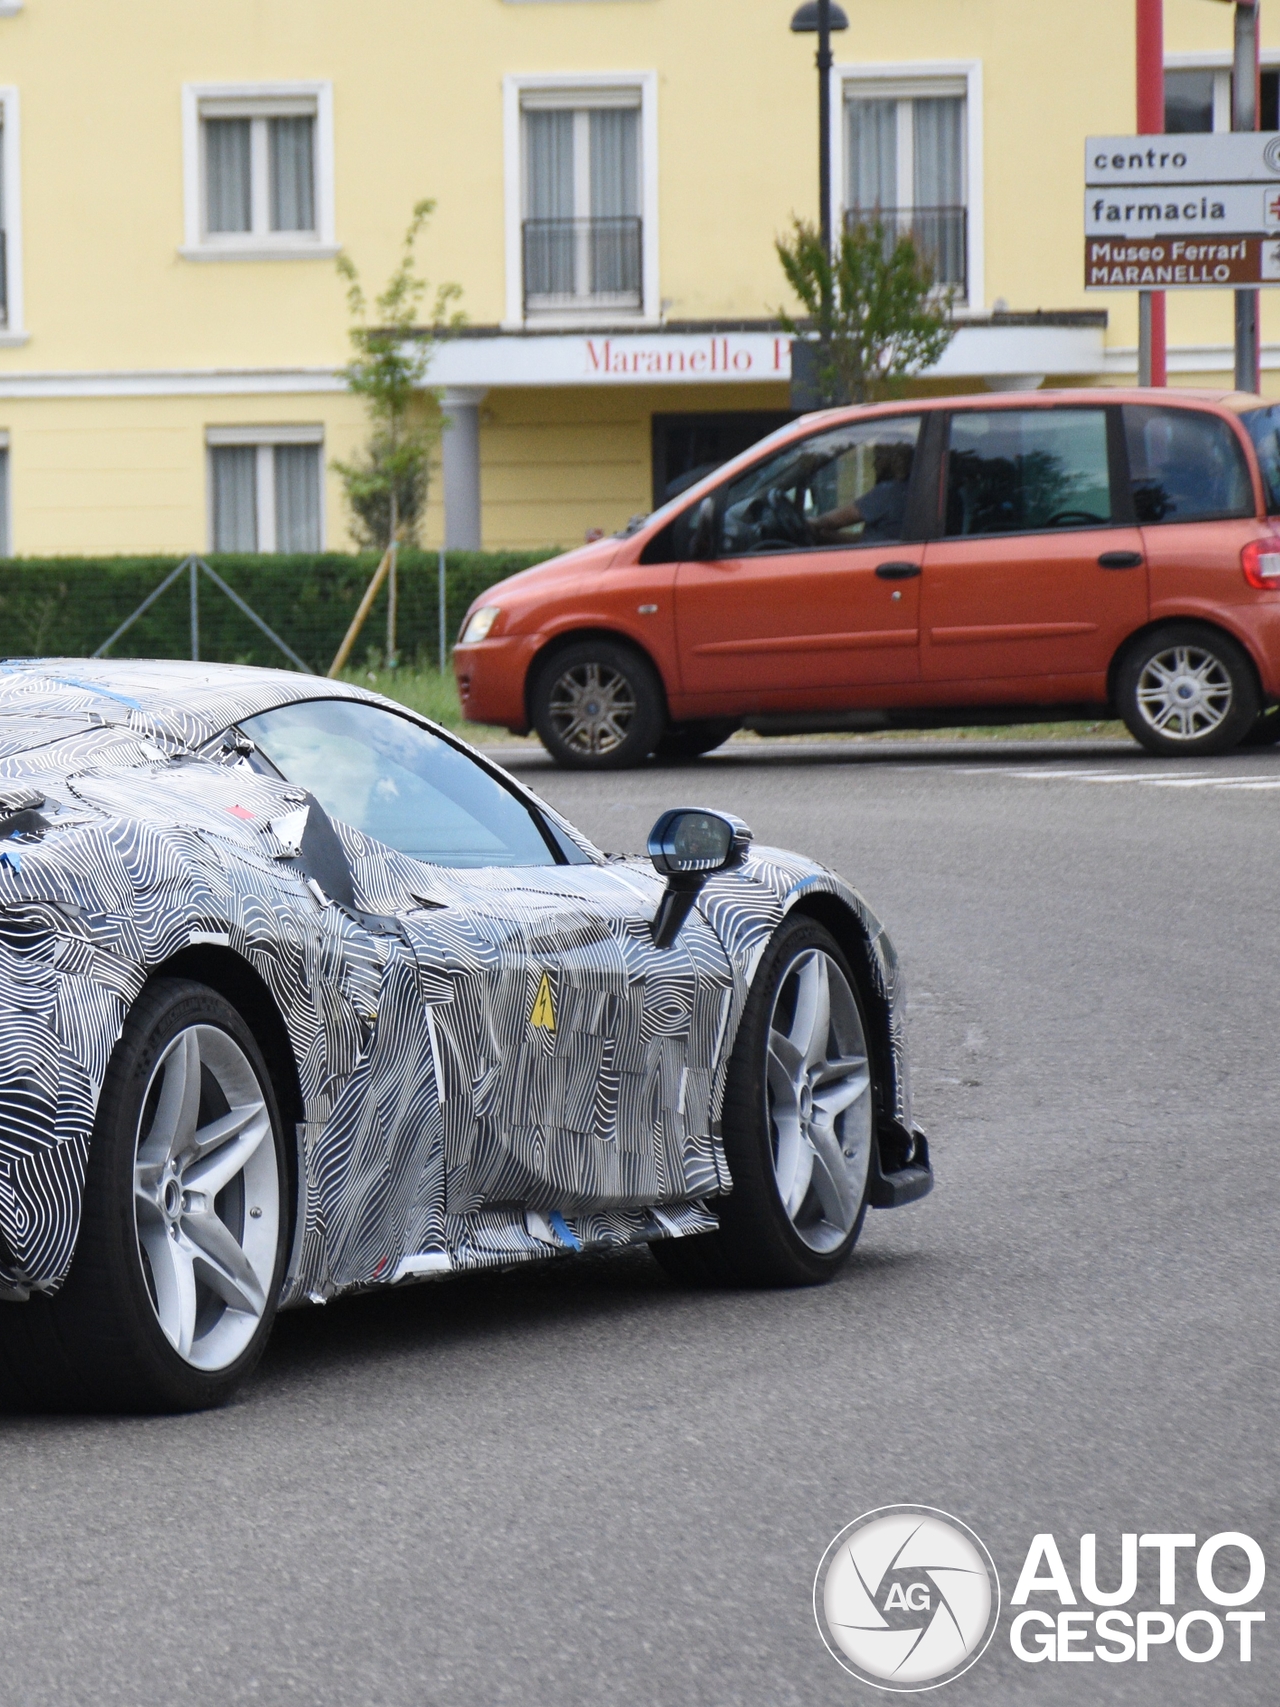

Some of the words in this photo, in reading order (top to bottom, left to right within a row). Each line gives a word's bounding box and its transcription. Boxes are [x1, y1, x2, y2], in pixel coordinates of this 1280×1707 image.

[1094, 148, 1187, 170] centro
[1092, 197, 1226, 221] farmacia
[1091, 243, 1165, 262] Museo
[1172, 241, 1247, 261] Ferrari
[1091, 264, 1231, 284] MARANELLO
[585, 337, 752, 373] Maranello
